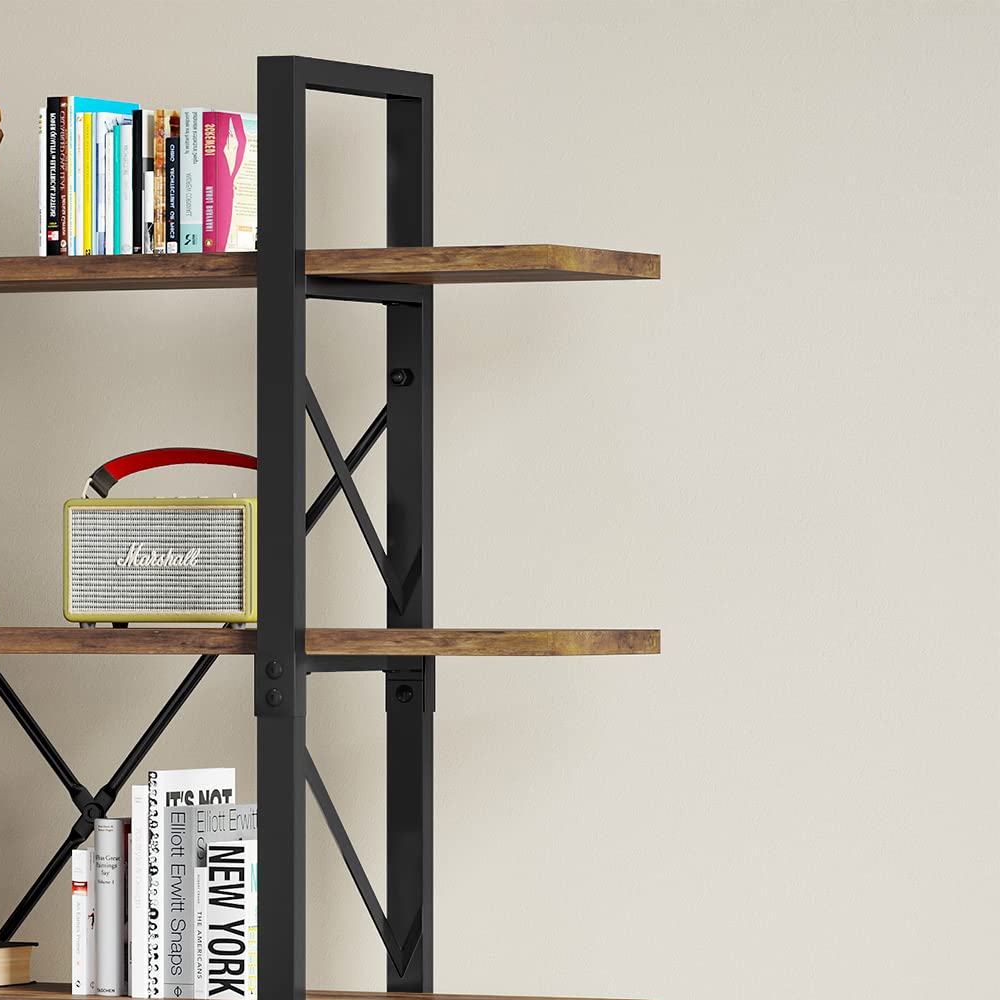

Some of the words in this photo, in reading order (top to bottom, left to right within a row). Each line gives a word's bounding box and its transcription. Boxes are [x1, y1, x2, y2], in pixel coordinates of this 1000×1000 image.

[116, 543, 200, 567] Marshall
[171, 812, 185, 857] Elliott
[197, 810, 225, 832] Elliott
[171, 864, 185, 912] Erwitt
[208, 846, 245, 909] NEW
[168, 918, 186, 976] Snaps
[208, 919, 246, 996] YORK
